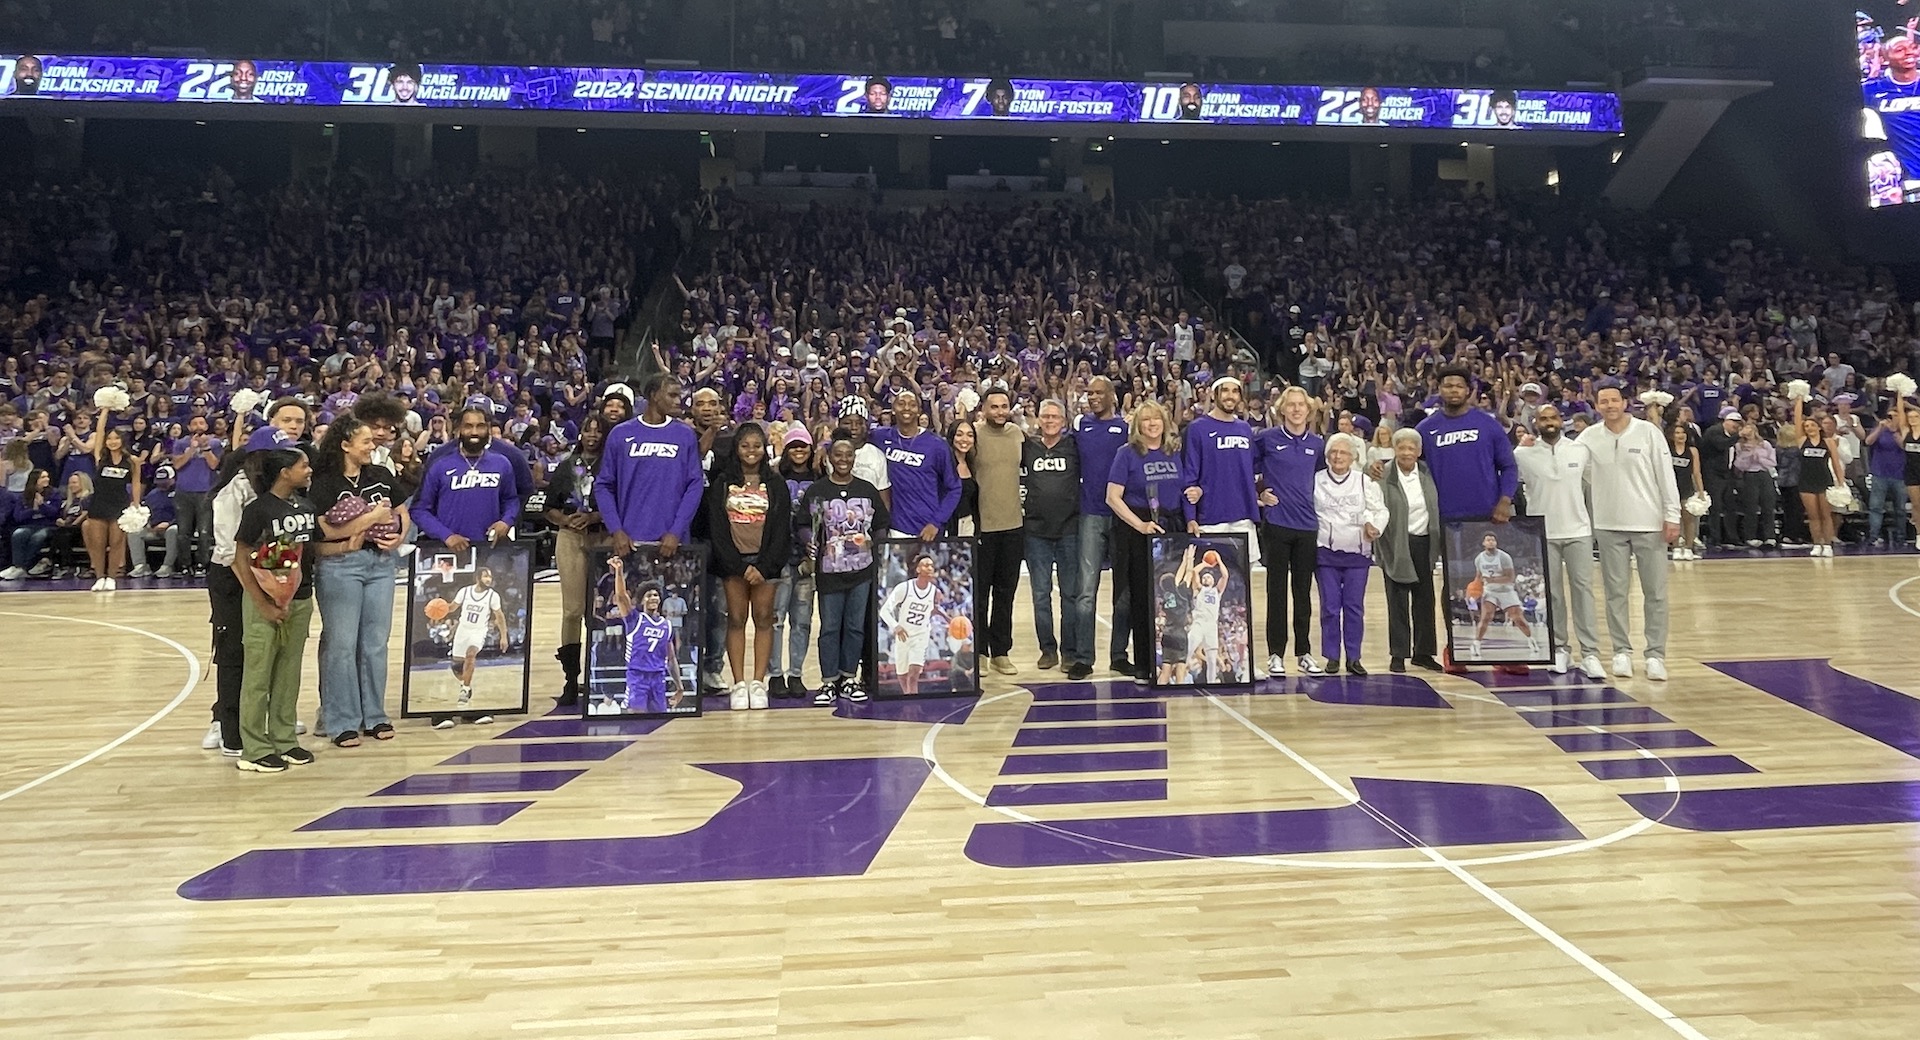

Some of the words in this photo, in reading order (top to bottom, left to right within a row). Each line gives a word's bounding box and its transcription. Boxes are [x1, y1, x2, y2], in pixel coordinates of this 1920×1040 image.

[43, 66, 88, 78] JOVAN
[258, 70, 295, 82] JOSH
[38, 78, 135, 93] BLACKSHER
[135, 79, 159, 94] JR
[178, 63, 235, 99] 22
[420, 73, 459, 86] GABE
[252, 82, 309, 97] BAKER
[416, 85, 511, 101] McGLOTHAN
[573, 81, 637, 99] 2024
[638, 82, 726, 101] SENIOR
[728, 85, 799, 103] NIGHT
[835, 80, 867, 113] 2
[892, 86, 943, 98] SYDNEY
[1013, 89, 1045, 101] TYON
[888, 97, 938, 111] CURRY
[960, 82, 989, 116] 7
[1140, 86, 1181, 120] 10
[1202, 93, 1241, 104] JOVAN
[1381, 95, 1412, 107] JOSH
[1516, 99, 1547, 111] GABE
[1009, 101, 1113, 115] GRANT-FOSTER
[1200, 104, 1280, 118] BLACKSHER
[1280, 105, 1301, 118] JR
[1317, 90, 1364, 123] 22
[1379, 107, 1424, 121] BAKER
[1514, 111, 1591, 125] McGLOTHAN
[1217, 435, 1250, 449] LOPES
[1436, 428, 1479, 447] LOPES
[629, 442, 679, 458] LOPES
[885, 447, 925, 467] LOPES
[1033, 457, 1067, 472] GCU
[1143, 461, 1178, 474] GCU
[450, 472, 501, 490] LOPES
[1204, 594, 1216, 604] 30
[466, 604, 484, 613] GCU
[909, 601, 929, 613] GCU
[467, 612, 480, 624] 10
[906, 611, 925, 626] 22
[643, 626, 665, 638] GCU
[648, 638, 659, 652] 7
